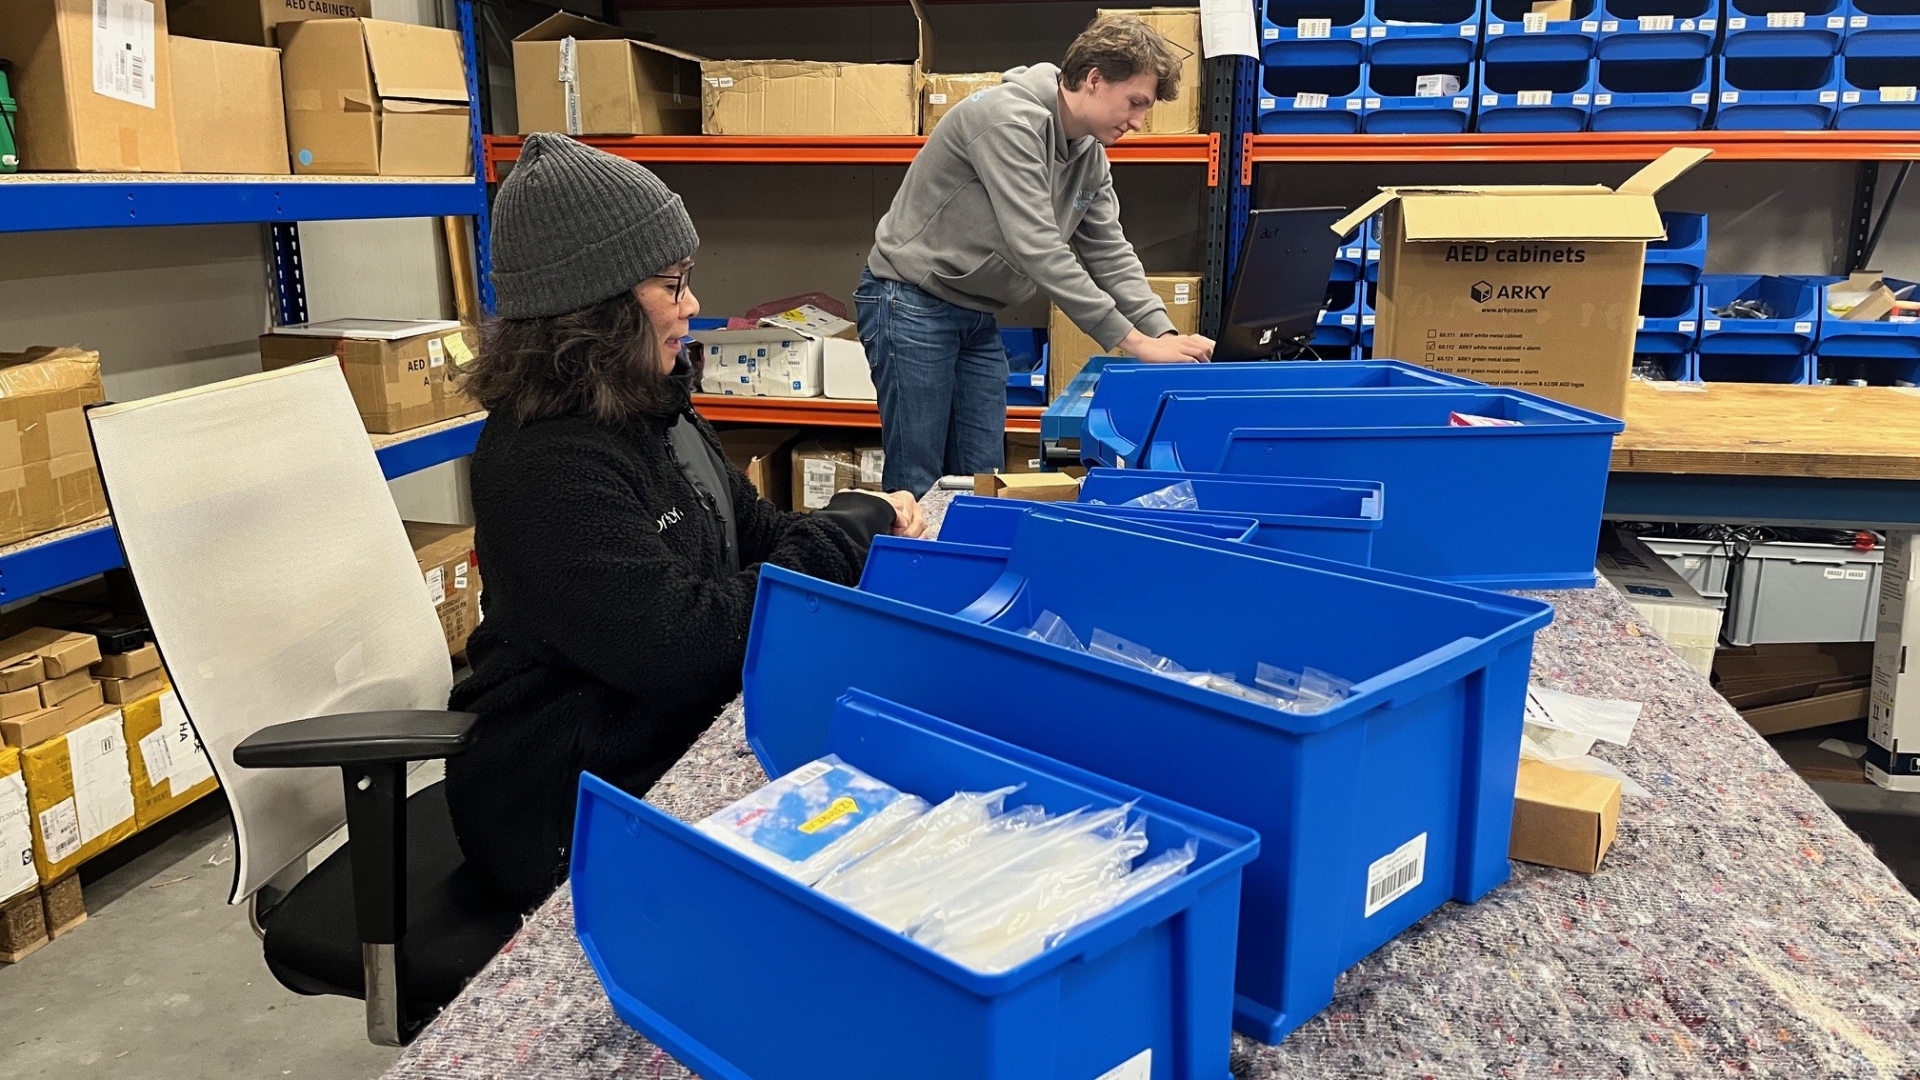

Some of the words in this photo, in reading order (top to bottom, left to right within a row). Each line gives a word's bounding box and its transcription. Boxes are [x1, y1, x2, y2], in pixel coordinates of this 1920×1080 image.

[286, 0, 306, 10] AED
[309, 1, 356, 17] CABINETS
[1260, 226, 1282, 240] acer
[1445, 245, 1488, 262] AED
[1496, 246, 1586, 262] cabinets
[1497, 285, 1551, 300] ARKY
[1481, 306, 1538, 314] www.arkycase.com
[408, 359, 426, 373] AED
